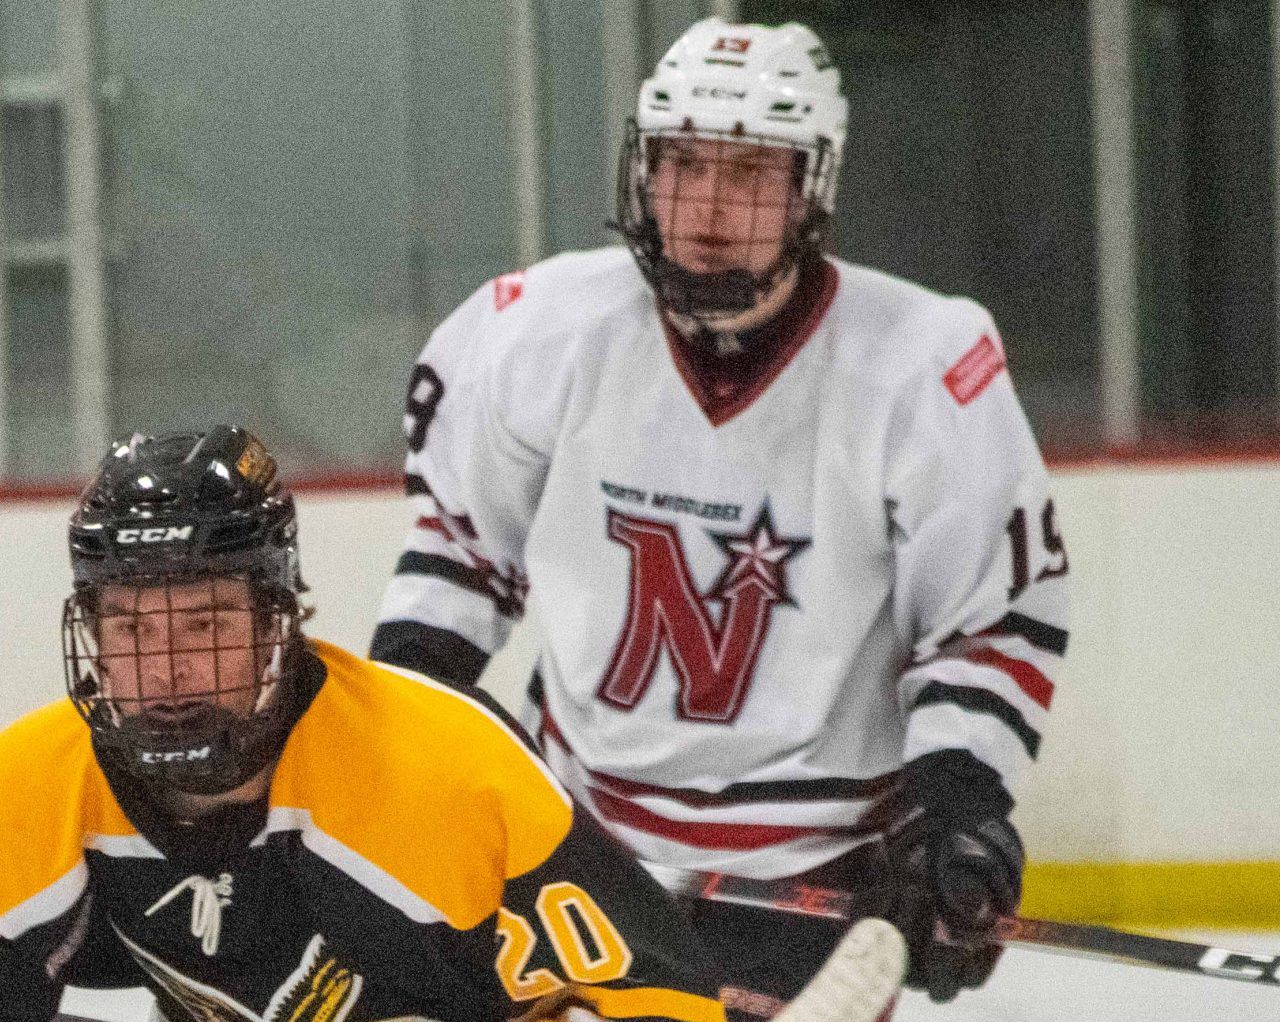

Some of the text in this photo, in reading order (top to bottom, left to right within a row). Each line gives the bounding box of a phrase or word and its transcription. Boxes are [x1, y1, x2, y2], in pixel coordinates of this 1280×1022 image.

[117, 525, 193, 543] CCM
[597, 505, 776, 725] N
[142, 746, 211, 763] CCM
[495, 877, 633, 1002] 20
